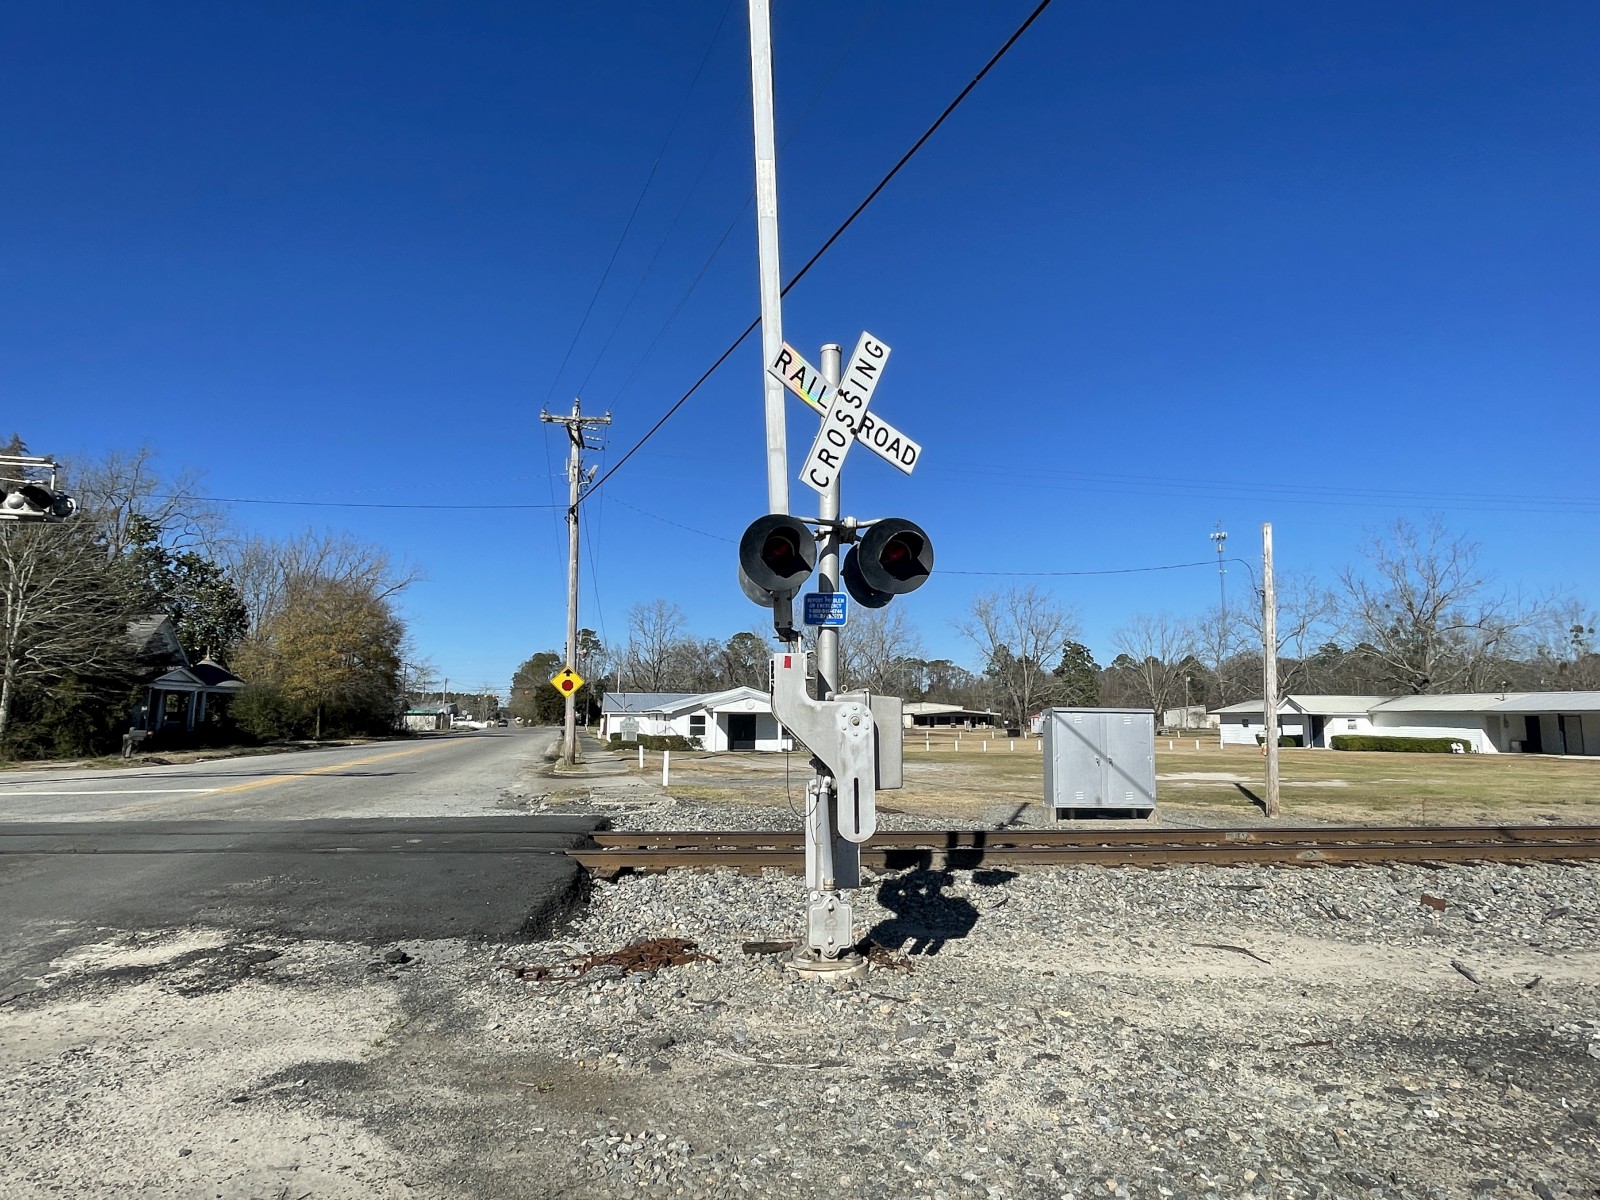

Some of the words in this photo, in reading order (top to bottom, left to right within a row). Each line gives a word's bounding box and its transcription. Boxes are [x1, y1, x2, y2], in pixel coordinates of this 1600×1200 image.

[774, 349, 828, 409] RAIL
[857, 416, 917, 466] ROAD
[810, 341, 884, 488] CROSSING
